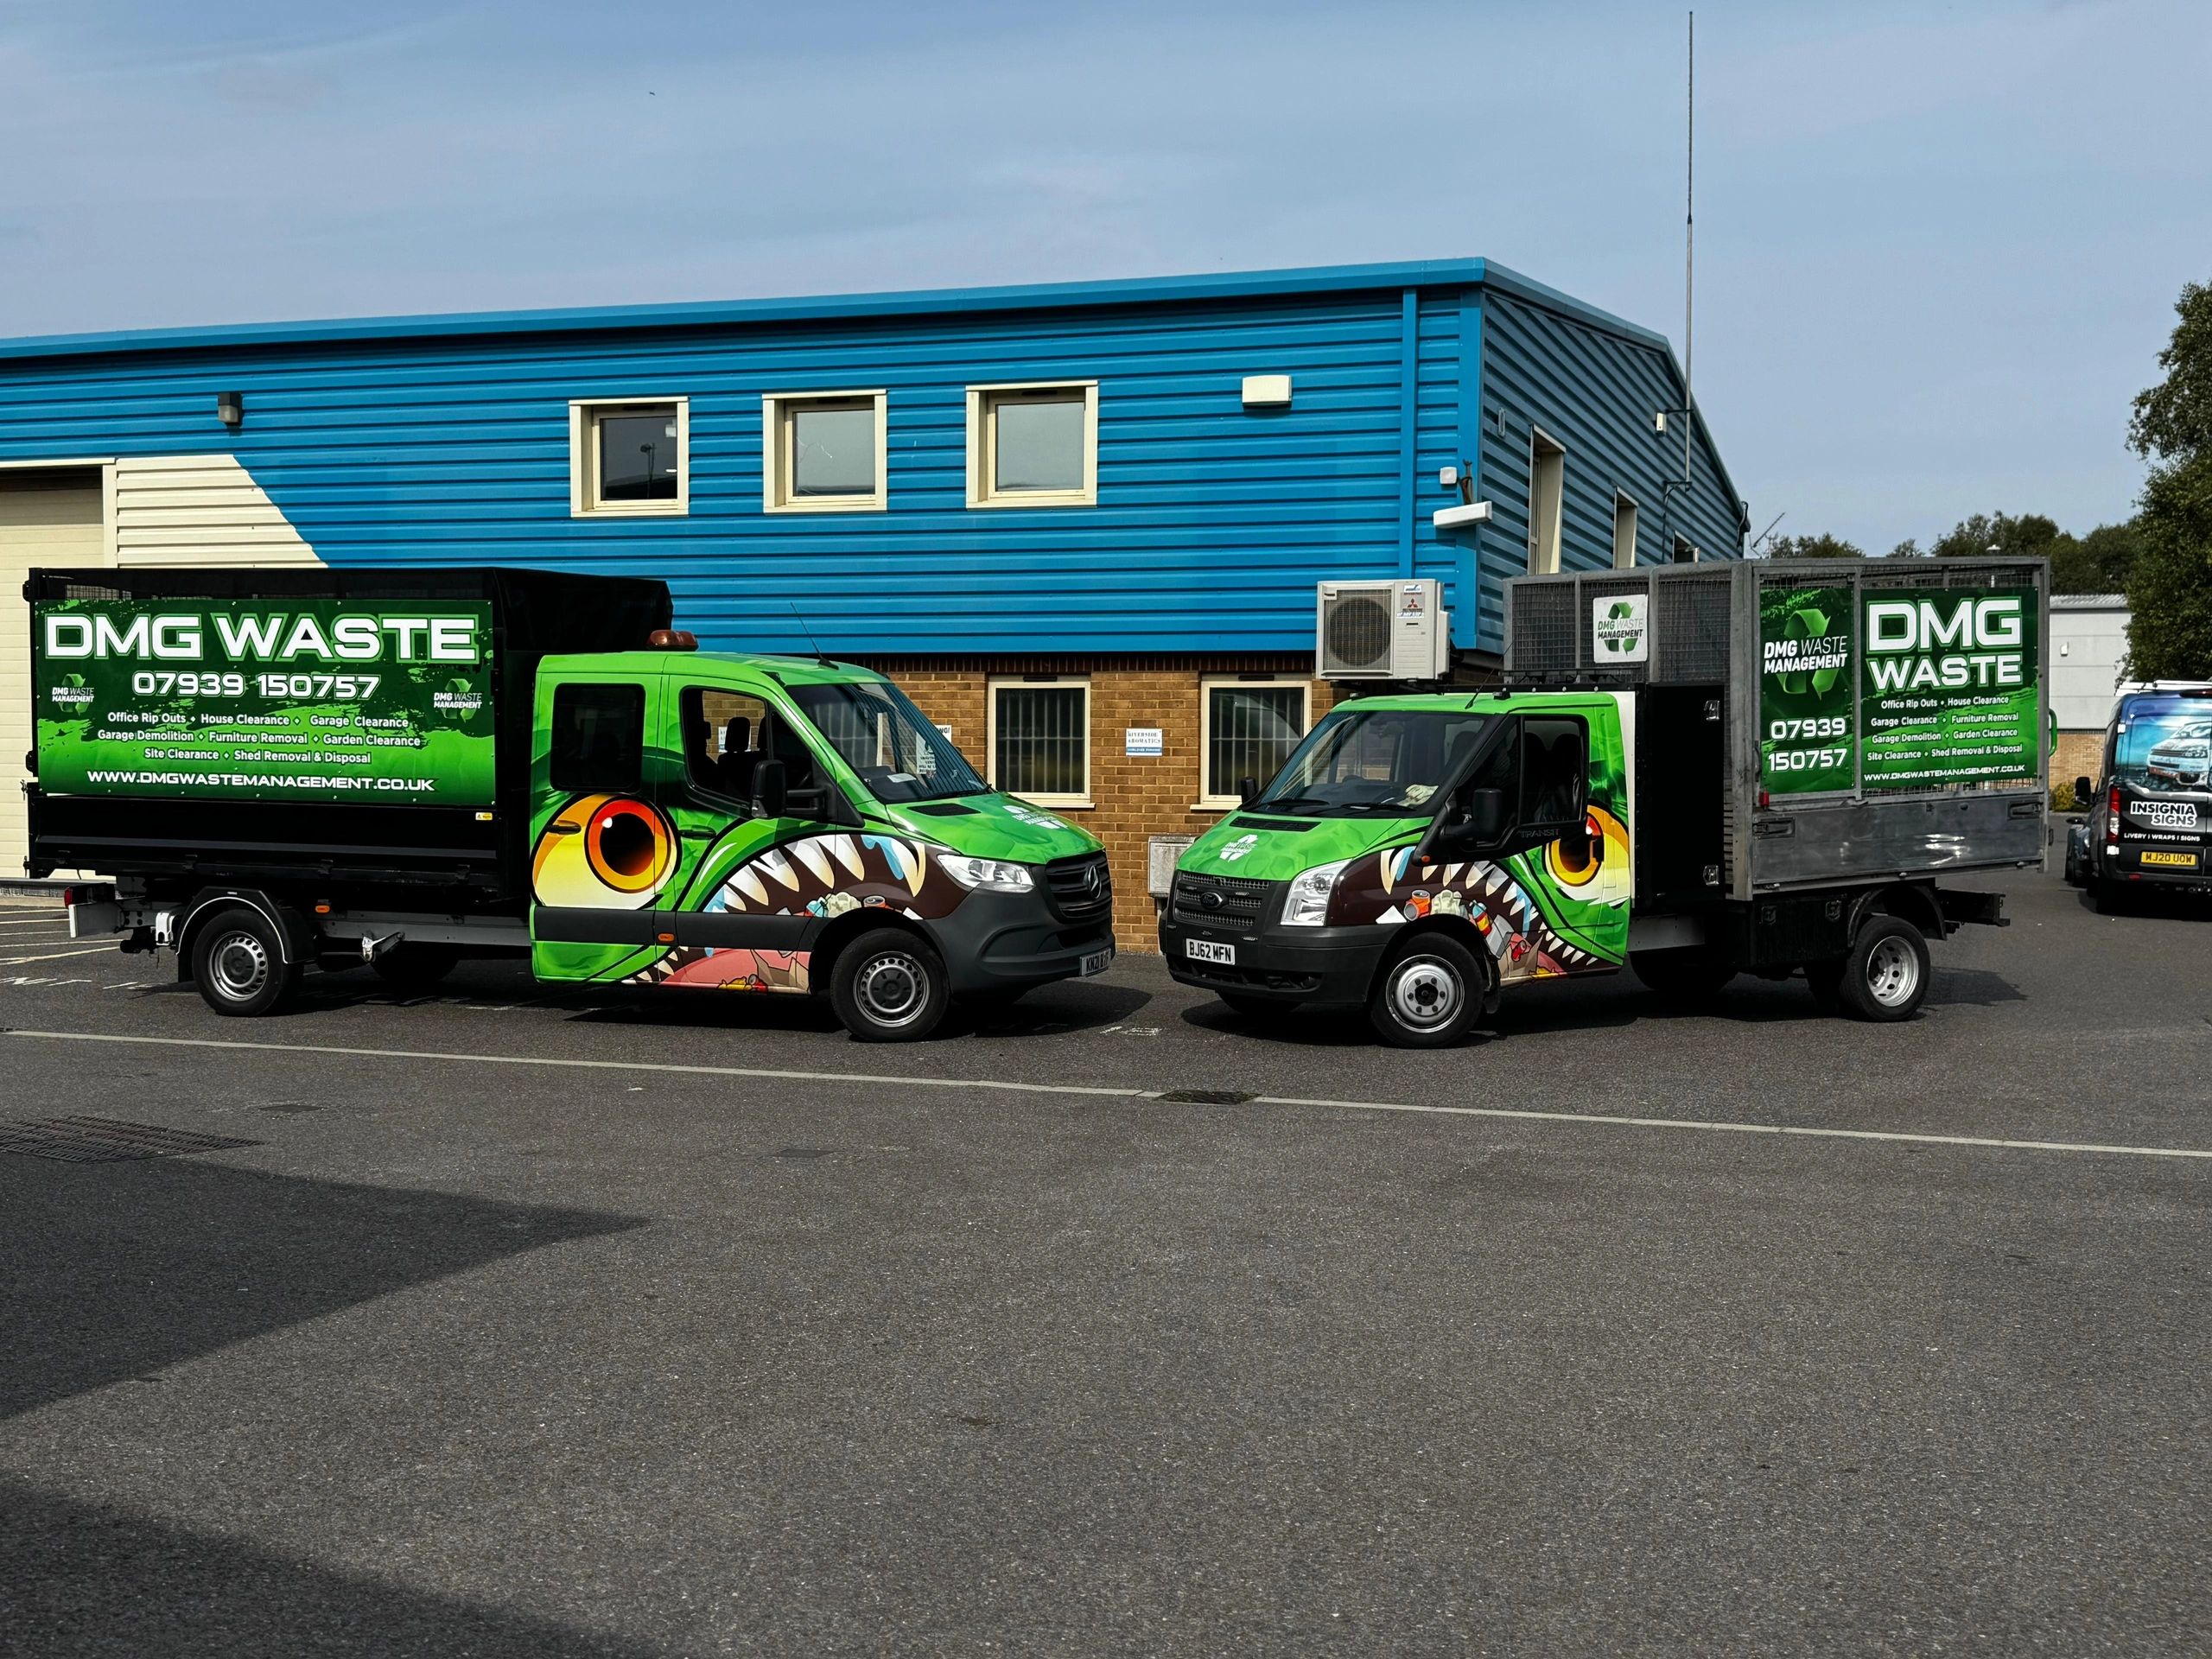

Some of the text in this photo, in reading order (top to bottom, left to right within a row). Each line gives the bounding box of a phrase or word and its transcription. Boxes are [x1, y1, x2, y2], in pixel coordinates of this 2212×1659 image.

[1598, 618, 1643, 631] DMG WASTE
[1867, 598, 2022, 652] DMG
[46, 614, 477, 662] DMG WASTE
[1598, 629, 1643, 639] MANAGEMENT
[1764, 636, 1847, 658] DMG WASTE
[1764, 653, 1848, 674] MANAGEMENT
[1867, 653, 2022, 690] WASTE
[132, 671, 380, 698] 07939 150757
[52, 687, 95, 696] DMG WASTE
[434, 692, 483, 702] DMG WASTE
[1881, 698, 1938, 709] Office Rip Outs
[1948, 696, 2009, 706] House Clearance
[108, 712, 186, 725] Office Rip Outs
[201, 714, 290, 725] House Clearance
[310, 715, 409, 728] Garage Clearance
[1871, 716, 1937, 727] Garage Clearance
[1951, 712, 2018, 724] Furniture Removal
[1770, 717, 1846, 740] 07939
[1953, 728, 2018, 740] Garden Clearance
[98, 729, 194, 741] Garage Demolition
[209, 731, 308, 743] Furniture Removal
[323, 734, 421, 746] Garden Clearance
[1872, 733, 1942, 744] Garage Demolition
[144, 748, 219, 760] Site Clearance
[1867, 750, 1921, 761] Site Clearance
[1931, 743, 2023, 757] Shed Removal & Disposal
[234, 749, 371, 765] Shed Removal & Disposal
[1769, 748, 1847, 771] 150757
[1864, 765, 2025, 781] WWW.DMGWASTEMANAGEMENT.CO.UK
[87, 772, 434, 791] WWW.DMGWASTEMANAGEMENT.CO.UK
[2132, 803, 2196, 815] INSIGNIA
[2152, 815, 2195, 825] SIGNS
[1189, 941, 1231, 962] BJ62 MFN
